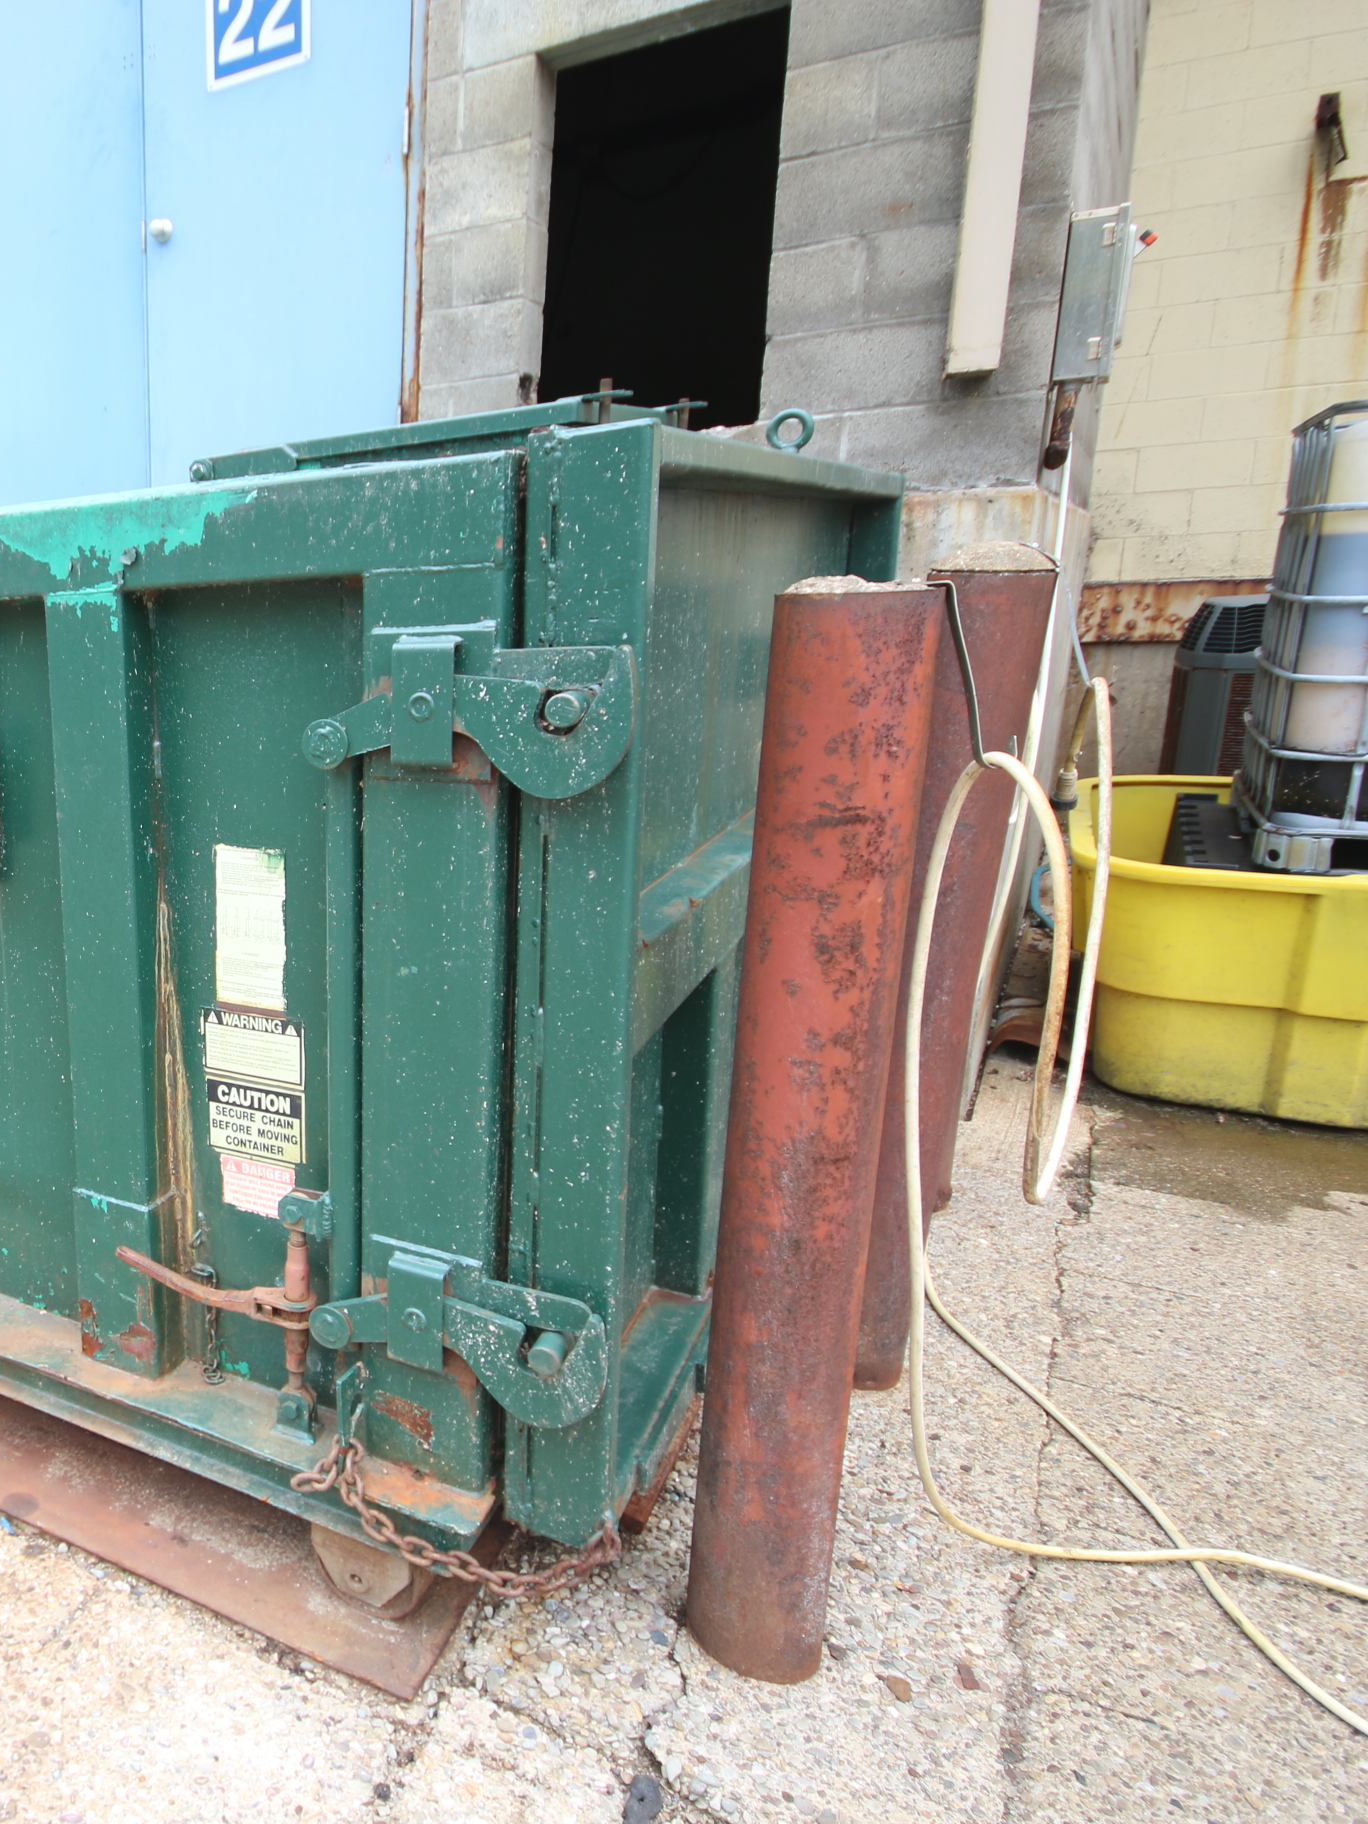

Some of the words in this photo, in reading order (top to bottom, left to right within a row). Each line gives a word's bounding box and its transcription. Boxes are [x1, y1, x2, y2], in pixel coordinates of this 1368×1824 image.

[218, 0, 296, 66] 22
[221, 1012, 283, 1034] WARNING
[217, 1084, 291, 1115] CAUTION
[215, 1105, 256, 1123] SECURE
[261, 1115, 294, 1130] CHAIN
[212, 1118, 252, 1136] BEFORE
[257, 1128, 298, 1145] MOVING
[225, 1135, 284, 1156] CONTAINER
[241, 1163, 291, 1183] DANGER
